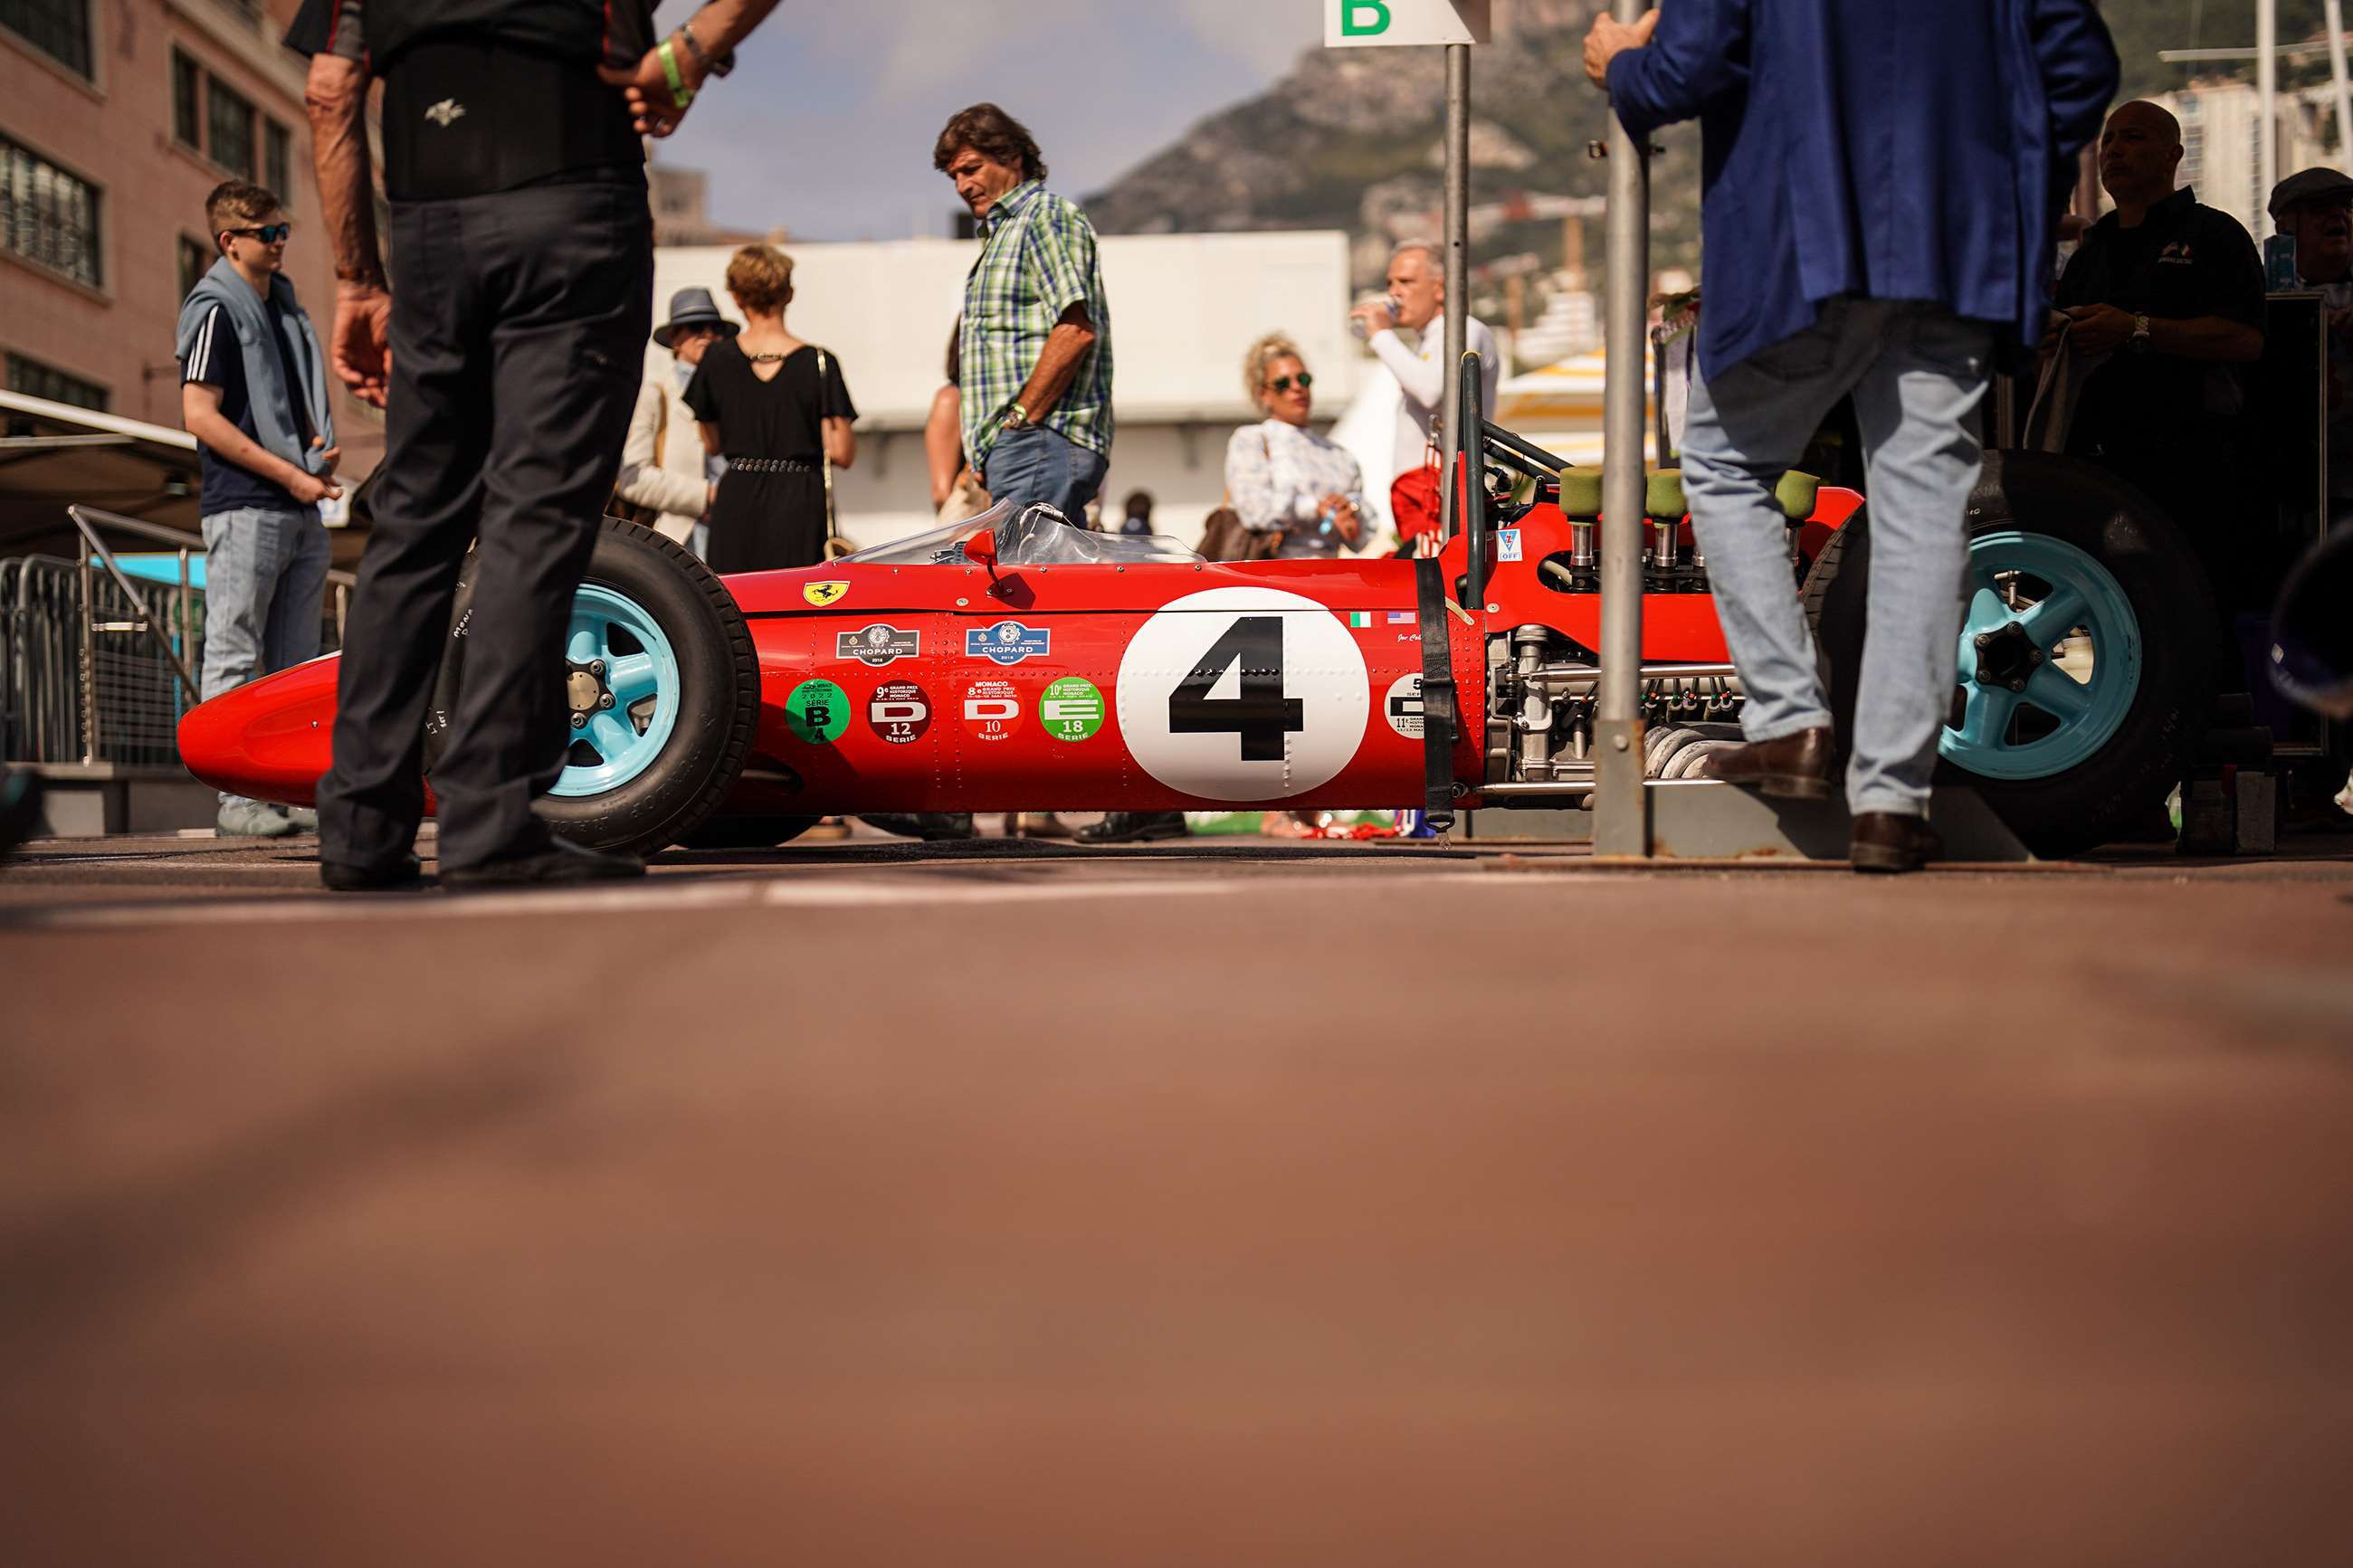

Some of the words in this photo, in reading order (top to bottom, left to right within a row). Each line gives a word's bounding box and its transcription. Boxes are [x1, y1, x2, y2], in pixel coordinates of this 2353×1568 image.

[1169, 616, 1303, 761] 4
[872, 701, 927, 723] D
[964, 698, 1019, 720] D
[1043, 699, 1100, 720] E
[805, 707, 832, 727] B
[891, 723, 911, 735] 12
[985, 720, 1001, 733] 10
[1062, 720, 1083, 733] 18
[885, 734, 917, 743] SERIE
[978, 732, 1008, 740] SERIE
[1058, 732, 1089, 741] SERIE
